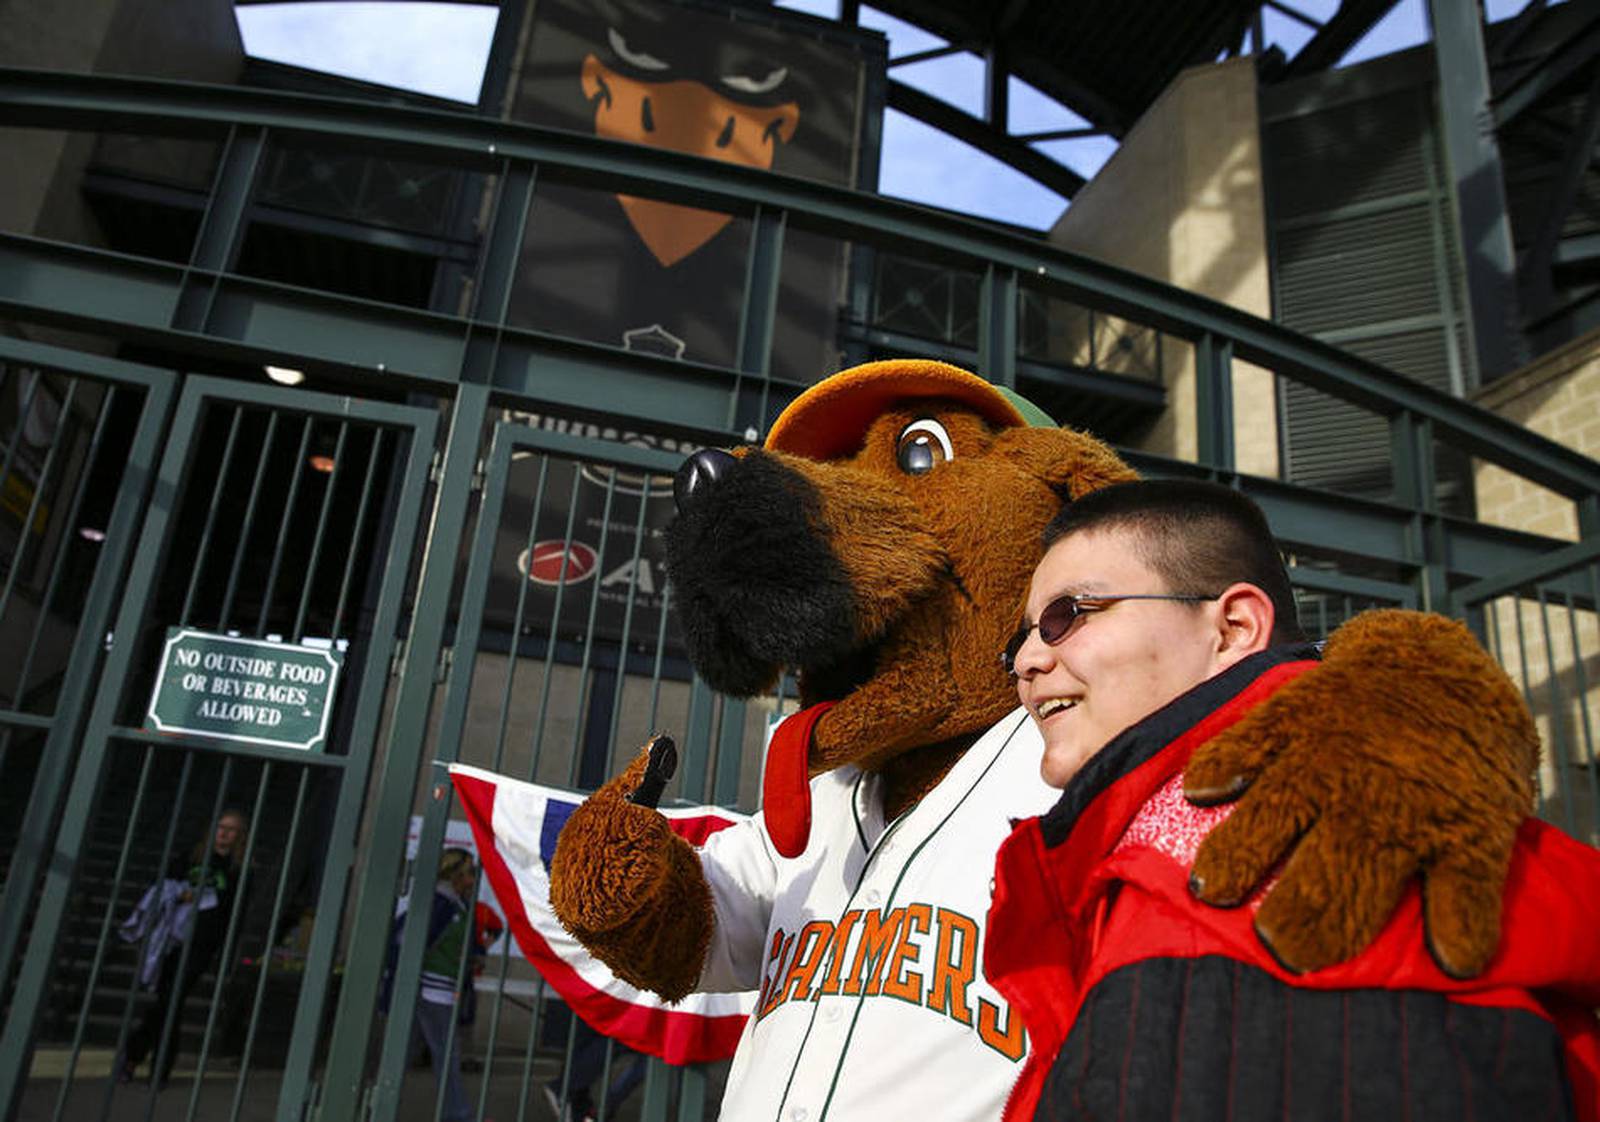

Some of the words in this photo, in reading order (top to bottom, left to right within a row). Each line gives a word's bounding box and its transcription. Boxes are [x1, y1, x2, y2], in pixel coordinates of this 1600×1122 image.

[174, 648, 201, 668] NO
[205, 652, 276, 678] OUTSIDE
[280, 662, 326, 684] FOOD
[182, 673, 207, 692] OR
[211, 677, 308, 705] BEVERAGES
[198, 699, 282, 726] ALLOWED
